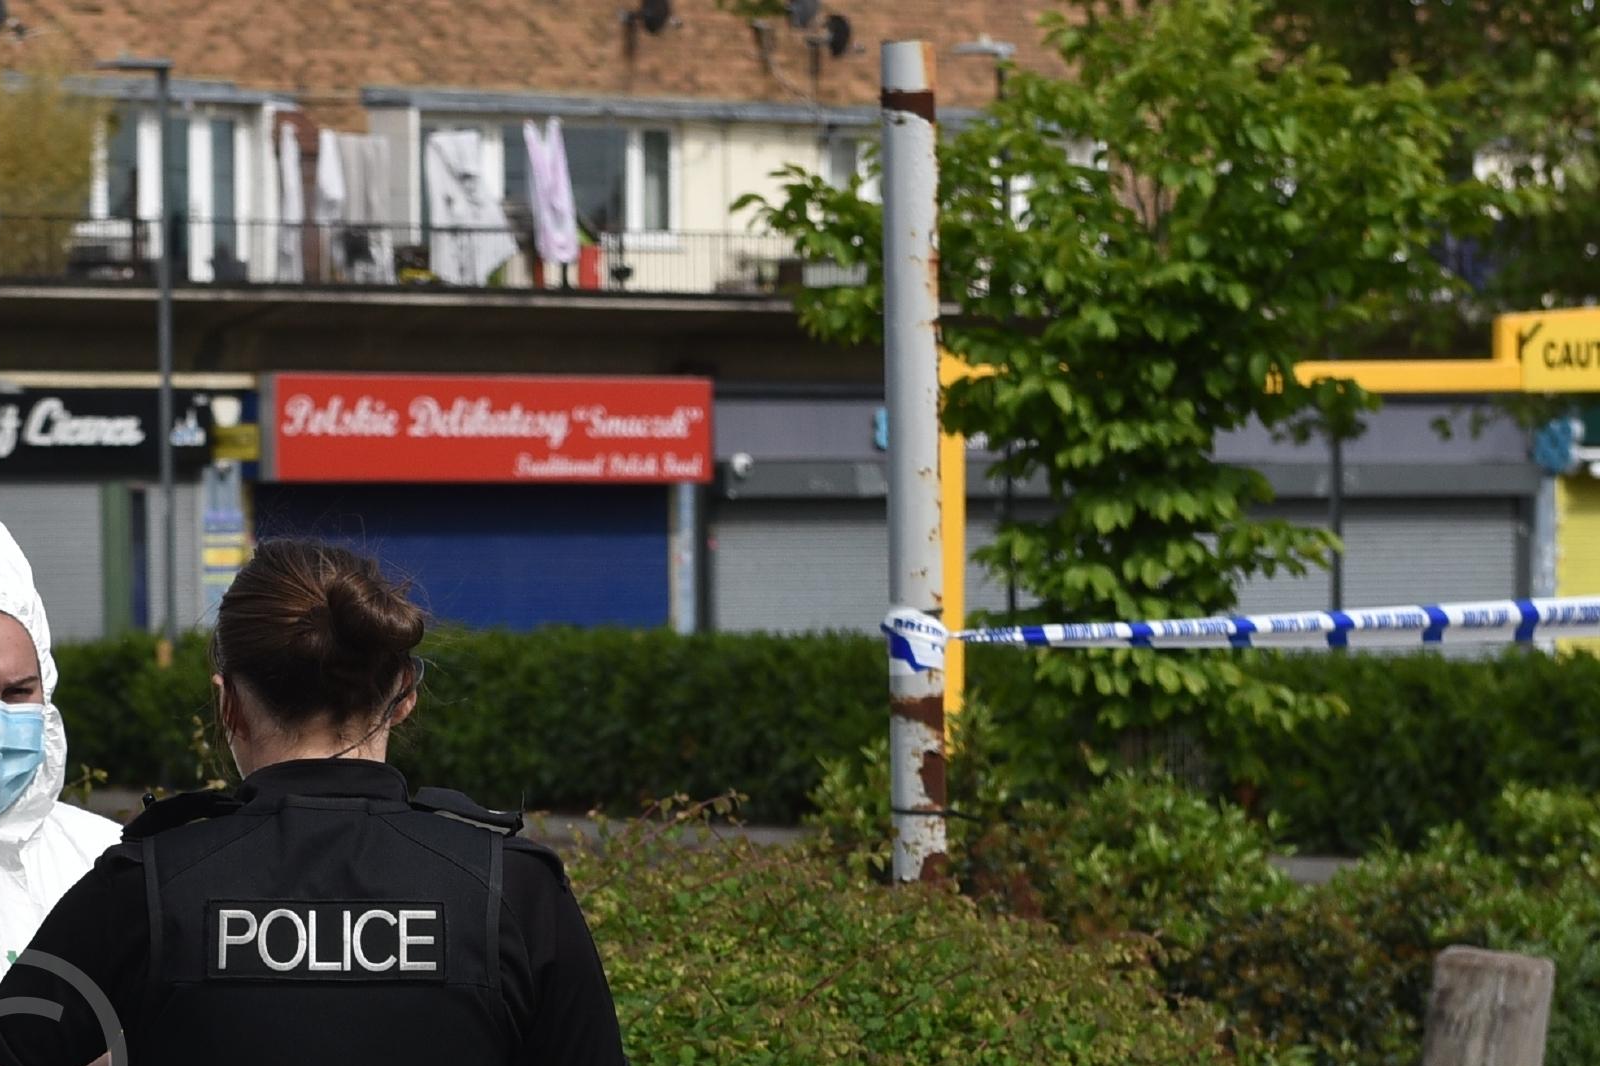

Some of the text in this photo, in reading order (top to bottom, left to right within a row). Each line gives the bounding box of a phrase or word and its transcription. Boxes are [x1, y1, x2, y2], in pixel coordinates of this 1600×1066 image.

[282, 394, 399, 437] Polskie
[408, 396, 569, 449] Delikatesy
[218, 908, 437, 972] POLICE
